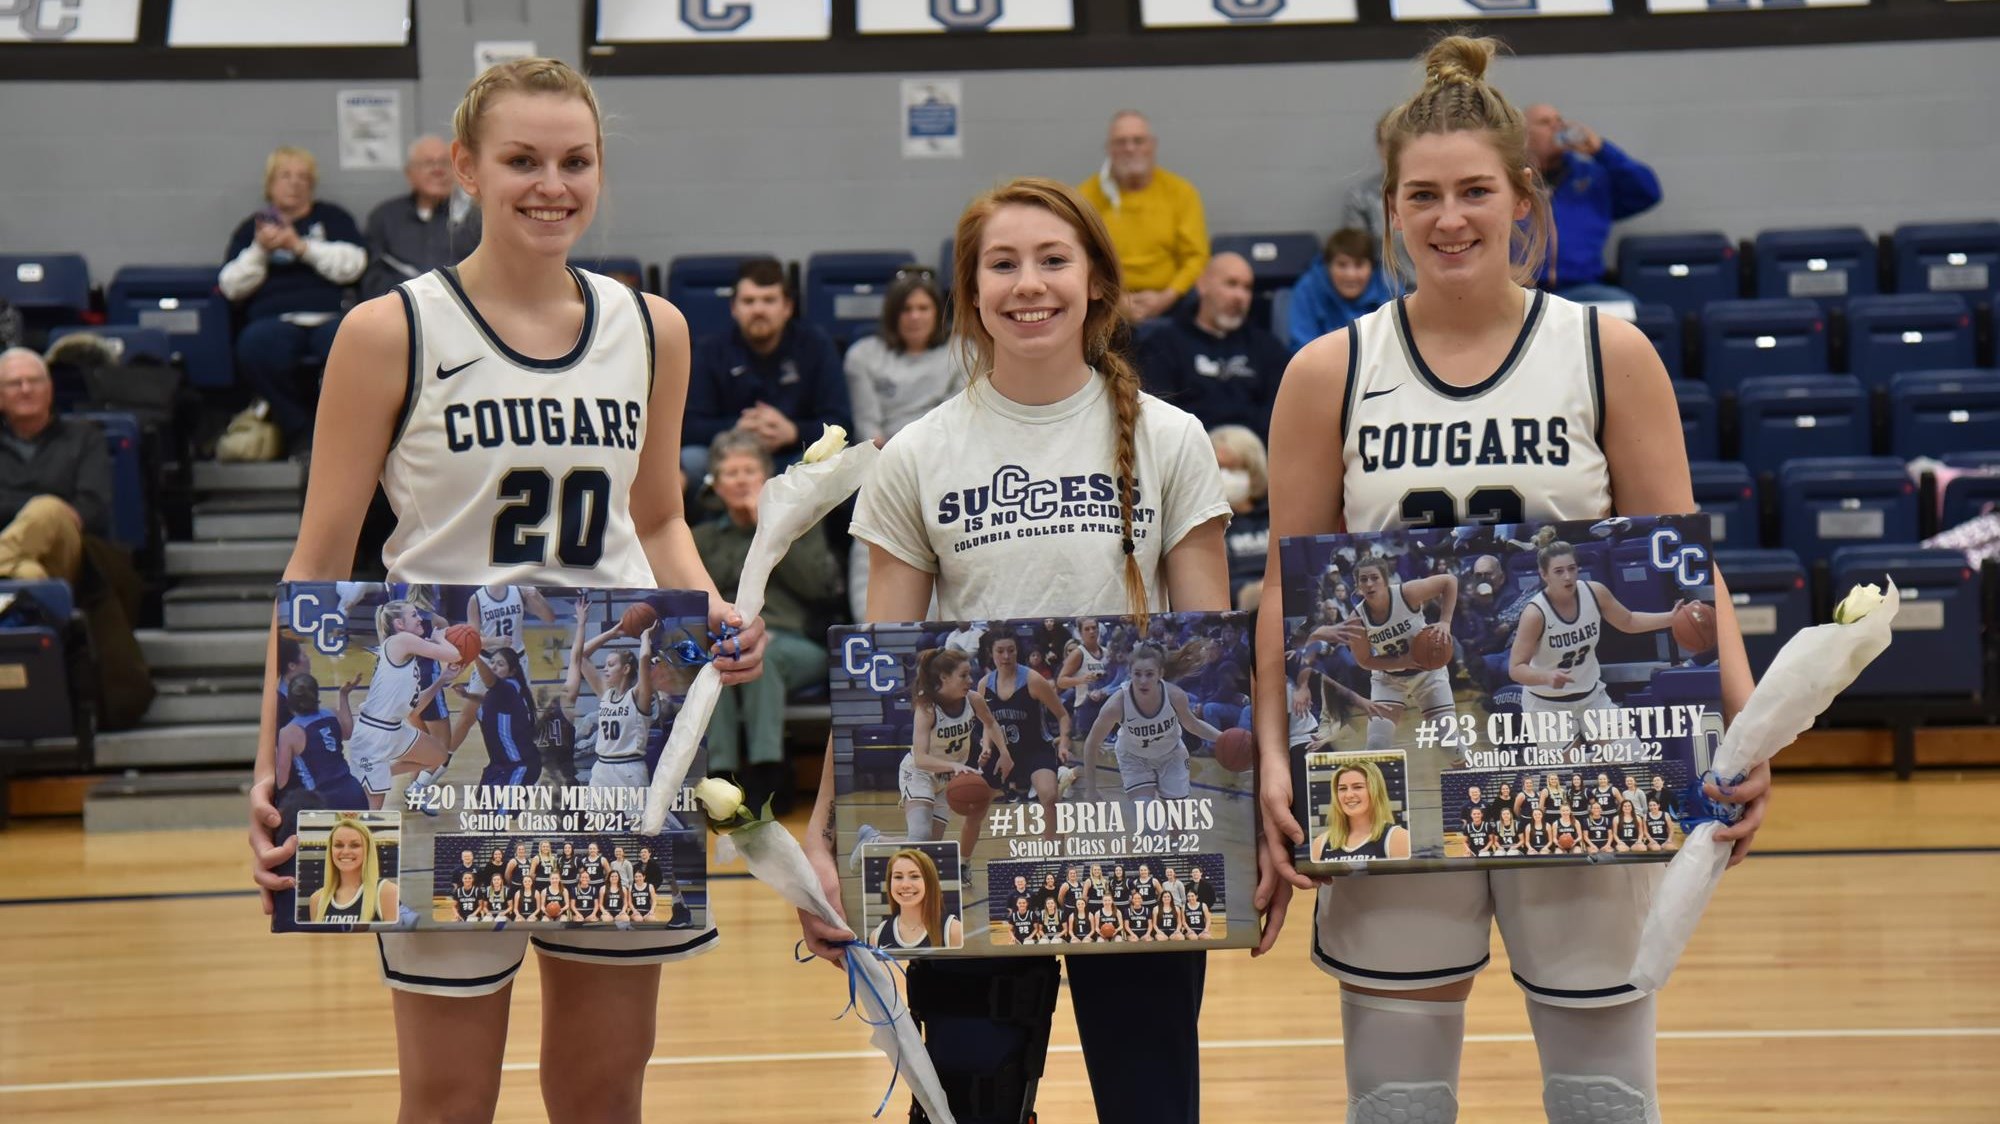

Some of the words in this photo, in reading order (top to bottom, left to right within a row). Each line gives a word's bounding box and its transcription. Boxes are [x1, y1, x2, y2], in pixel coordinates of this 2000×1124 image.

[443, 397, 641, 453] COUGARS
[1358, 416, 1570, 473] COUGARS
[488, 466, 612, 570] 20
[964, 516, 984, 533] IS
[990, 511, 1018, 527] NO
[954, 529, 1011, 553] COLUMBIA
[1016, 523, 1075, 538] COLLEGE
[1650, 529, 1706, 587] CC
[289, 590, 347, 655] CC
[484, 603, 521, 621] COUGARS
[496, 618, 513, 637] 12
[1548, 622, 1598, 648] COUGARS
[843, 635, 897, 694] CC
[1415, 714, 1477, 749] #23
[1487, 710, 1575, 745] CLARE
[1579, 704, 1706, 742] SHETLEY
[1465, 747, 1518, 768] Senior
[1523, 745, 1564, 767] Class
[1568, 743, 1588, 764] of
[1591, 742, 1663, 763] 2021-22
[407, 784, 456, 811] #20
[463, 785, 553, 812] KAMRYN
[459, 811, 511, 831] Senior
[518, 811, 557, 832] Class
[562, 812, 579, 831] of
[989, 803, 1046, 837] #13
[1055, 801, 1125, 834] BRIA
[1133, 798, 1215, 836] JONES
[1008, 838, 1061, 858] Senior
[1066, 837, 1106, 856] Class
[1111, 836, 1127, 855] of
[1131, 833, 1200, 854] 2021-22
